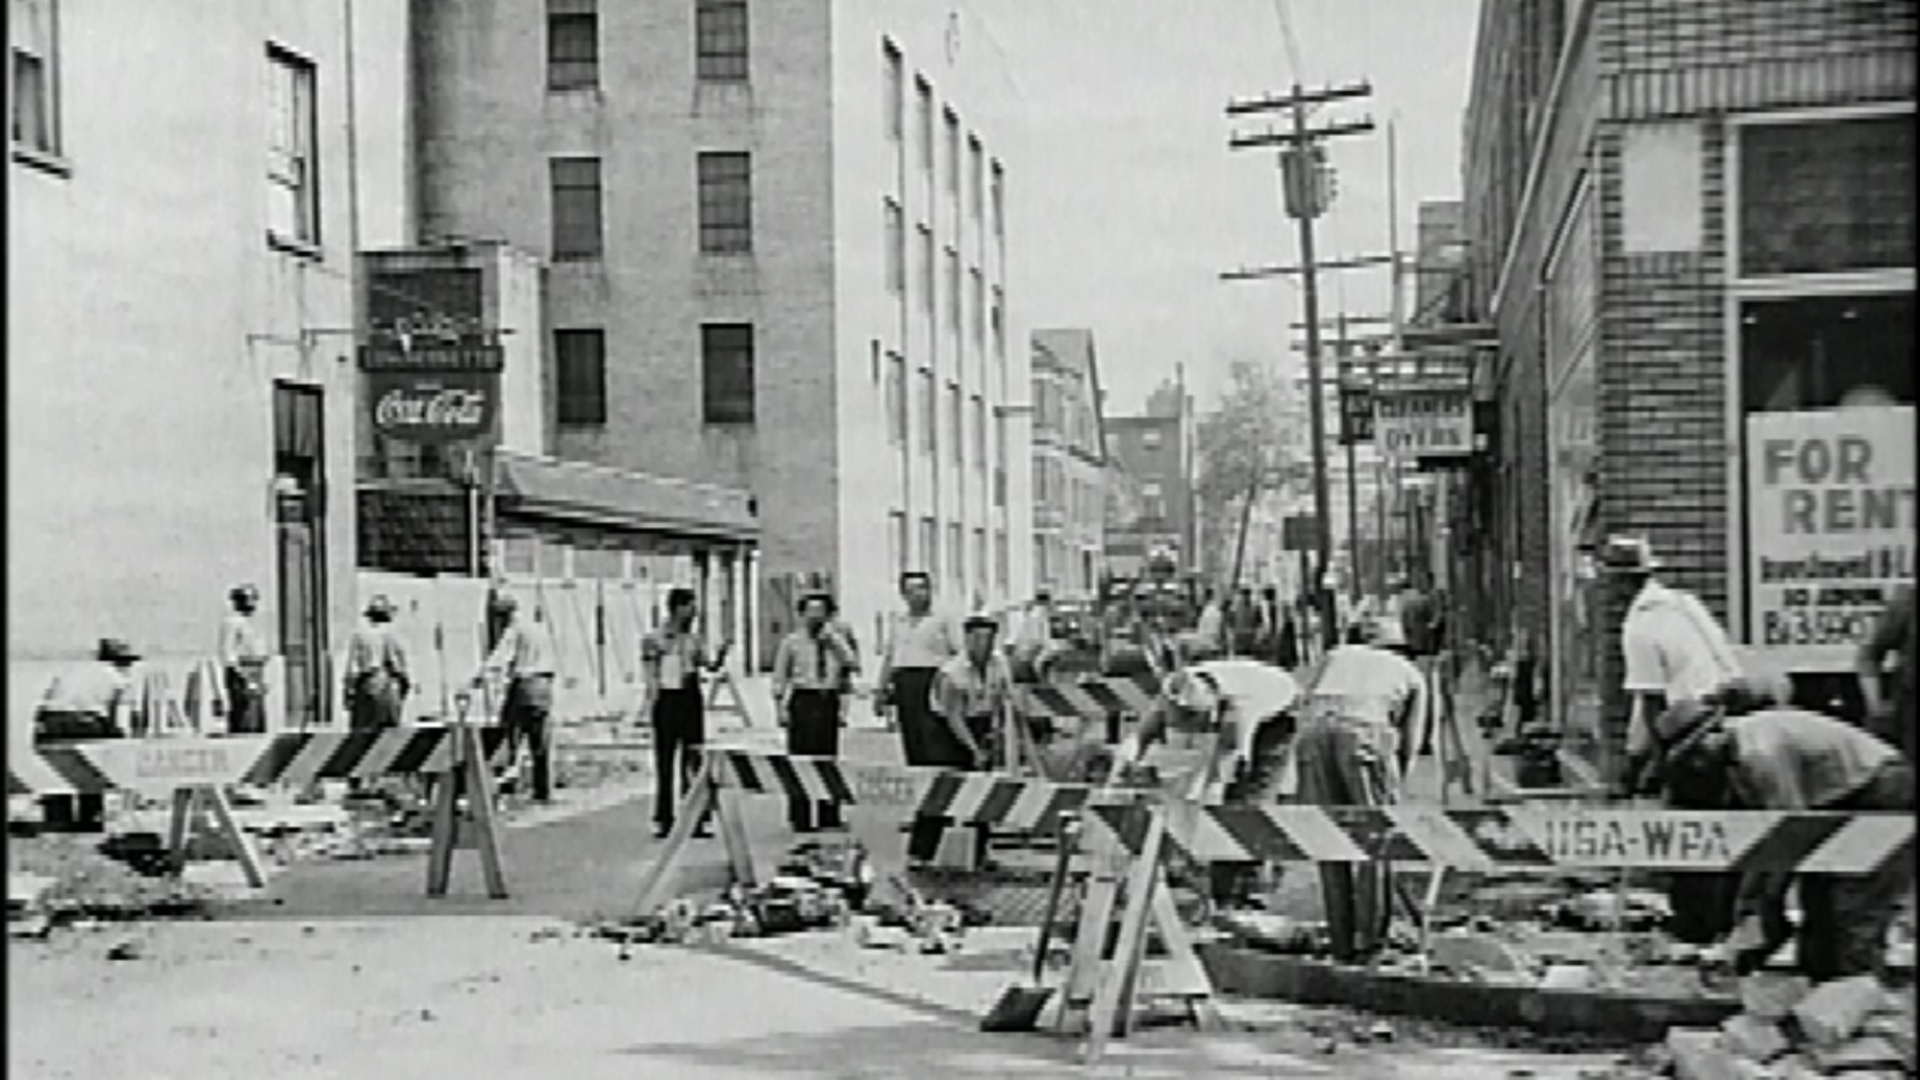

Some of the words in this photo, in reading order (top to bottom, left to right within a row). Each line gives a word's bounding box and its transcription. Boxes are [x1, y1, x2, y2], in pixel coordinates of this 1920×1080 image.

[1387, 428, 1462, 449] DYERS
[1763, 436, 1872, 485] FOR
[1546, 821, 1731, 861] USA-WPA
